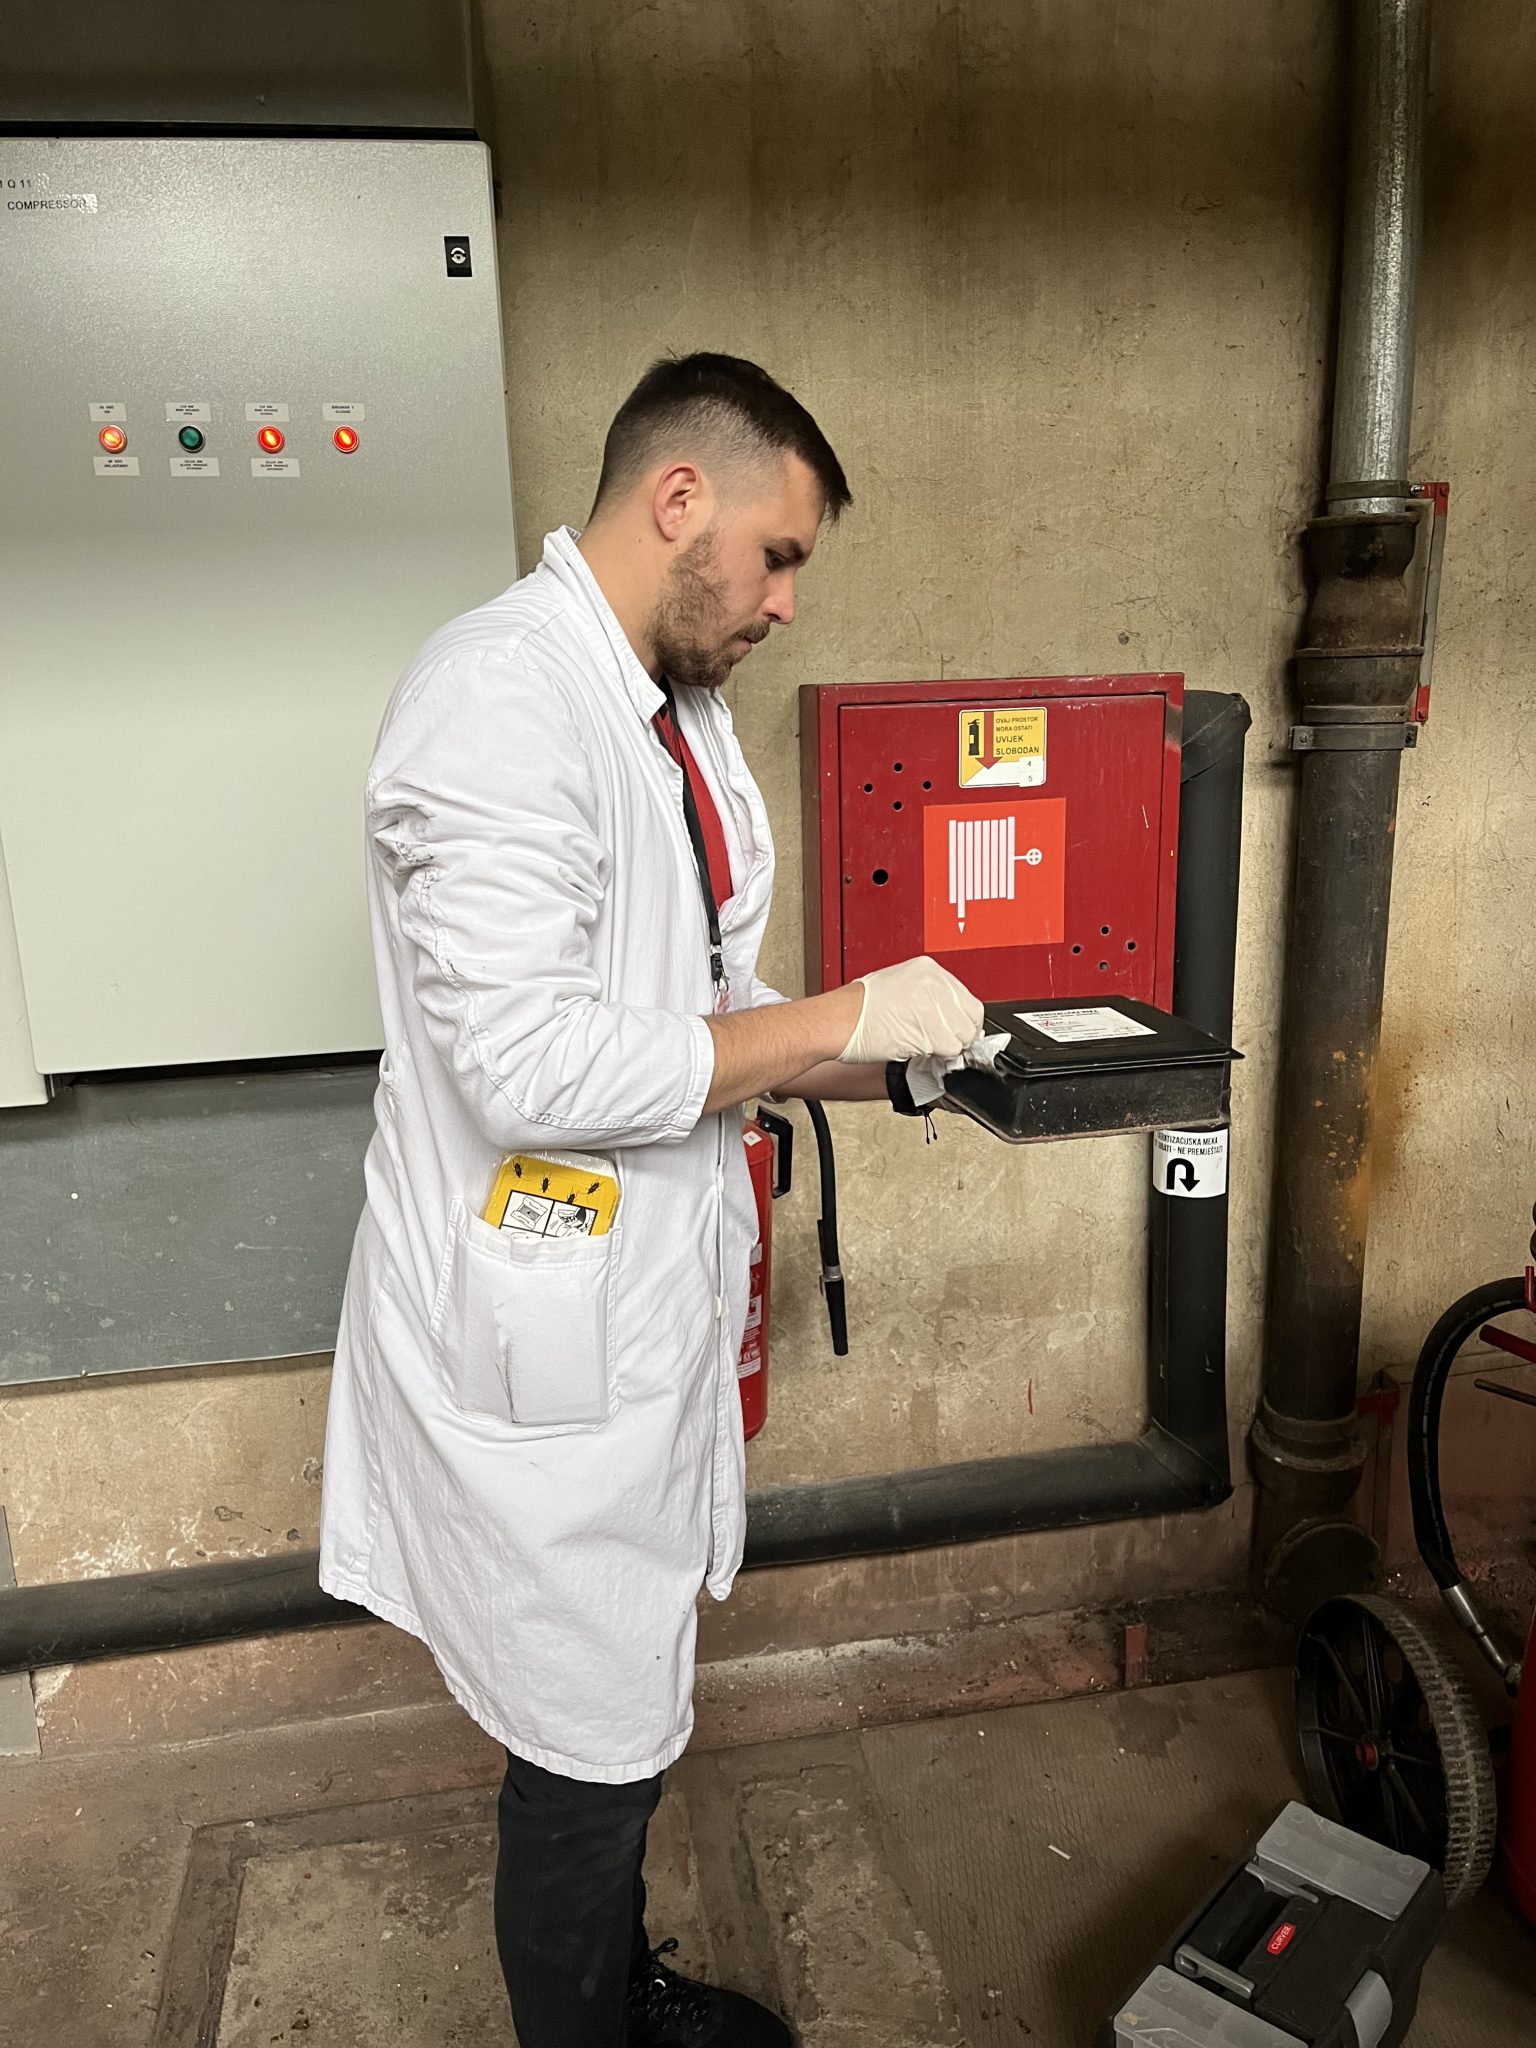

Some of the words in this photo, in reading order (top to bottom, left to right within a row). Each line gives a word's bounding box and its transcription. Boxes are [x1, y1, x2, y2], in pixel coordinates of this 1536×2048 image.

[7, 179, 16, 189] Q
[7, 199, 87, 211] COMPRESSOR
[995, 735, 1024, 744] UVIJEK
[995, 747, 1040, 755] SLOBODAN
[1203, 1137, 1218, 1146] MEKA
[1177, 1146, 1187, 1155] NE
